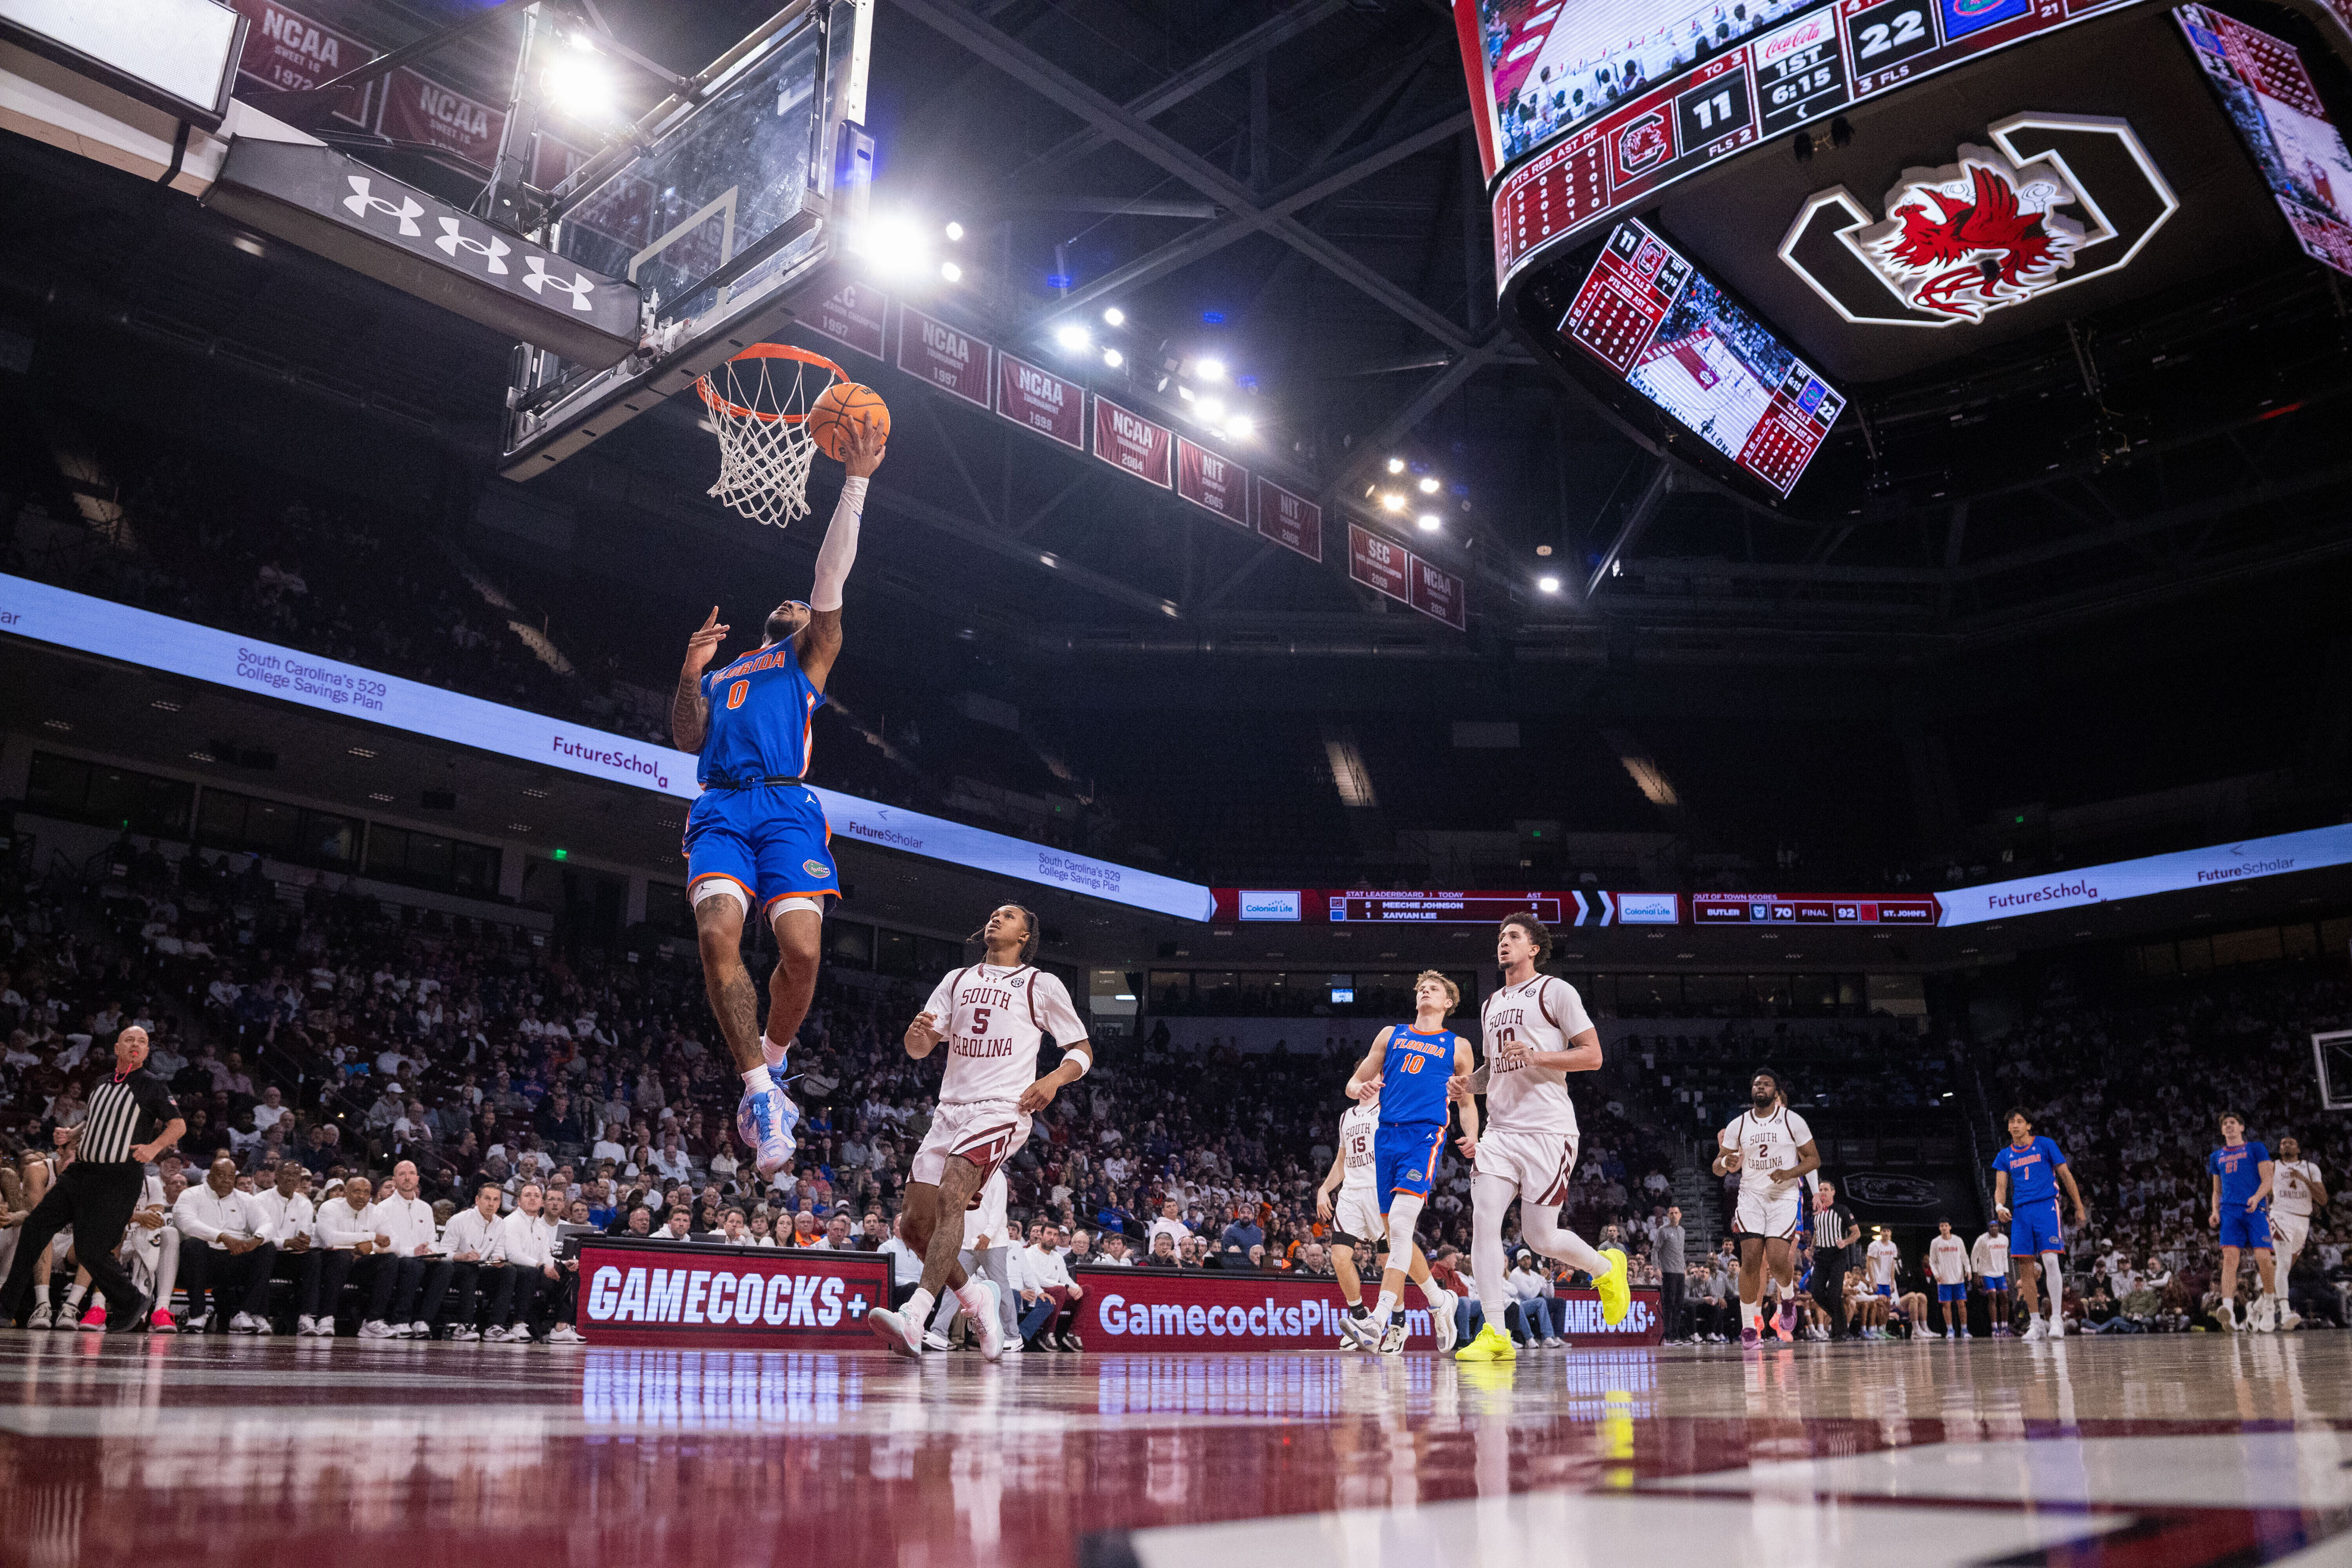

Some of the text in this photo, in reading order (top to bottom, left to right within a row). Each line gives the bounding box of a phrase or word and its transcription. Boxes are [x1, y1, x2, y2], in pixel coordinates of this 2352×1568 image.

[2041, 3, 2058, 17] 21
[262, 8, 338, 68] NCAA
[1859, 10, 1925, 60] 22
[275, 44, 305, 66] SWEET
[1704, 50, 1744, 78] TO 3
[1775, 44, 1823, 78] 1ST
[1772, 67, 1831, 105] 6:15
[1859, 65, 1910, 93] 3 FLS
[420, 84, 488, 139] NCAA
[1693, 90, 1732, 130] 11
[1708, 128, 1751, 157] FLS 2
[1512, 128, 1598, 190] PTS REB AST PF
[1517, 148, 1596, 200] 0 0 0 0
[1518, 160, 1595, 212] 3 2 0 1
[1518, 172, 1598, 225] 0 0 2 0
[1519, 185, 1597, 237] 0 1 0 1
[1519, 197, 1600, 249] 0 0 1 0
[1619, 230, 1637, 252] 11
[1619, 265, 1651, 294] TO 3 FLS 2
[1661, 270, 1678, 287] 6:15
[1670, 259, 1684, 273] 1ST
[1608, 275, 1655, 314] PTS REB AST PF
[923, 321, 969, 363] NCAA
[933, 367, 957, 387] 1997
[1019, 367, 1064, 407] NCAA
[1787, 377, 1802, 391] 6:15
[1796, 367, 1807, 379] 1ST
[1817, 401, 1836, 421] 22
[1113, 410, 1153, 448] NCAA
[1122, 453, 1143, 473] 2004
[1202, 455, 1224, 483] NIT
[1281, 494, 1300, 519] NIT
[1368, 539, 1390, 565] SEC
[1423, 566, 1451, 597] NCAA
[238, 648, 387, 697] South Carolina's 529
[711, 651, 785, 688] FLORIDA
[237, 663, 384, 711] College Savings Plan
[726, 679, 750, 710] 0
[849, 821, 923, 849] FutureScholar
[1039, 853, 1121, 882] South Carolina's 529
[1039, 864, 1120, 892] College Savings Plan
[2197, 858, 2294, 883] FutureScholar
[1989, 880, 2108, 909] FutureSchola
[1775, 908, 1792, 918] 70
[1838, 908, 1855, 918] 92
[960, 988, 1012, 1010] SOUTH
[971, 1008, 991, 1035] 5
[1489, 1008, 1524, 1033] SOUTH
[952, 1033, 1012, 1058] CAROLINA
[1392, 1038, 1446, 1059] FLORIDA
[1400, 1053, 1425, 1074] 10
[1346, 1123, 1371, 1140] SOUTH
[1352, 1136, 1366, 1154] 15
[1750, 1132, 1777, 1145] SOUTH
[1345, 1151, 1375, 1168] CAROLIN
[1749, 1156, 1783, 1170] CAROLINA
[1759, 1144, 1768, 1158] 2
[2024, 1166, 2029, 1180] 1
[587, 1265, 867, 1327] GAMECOCKS+
